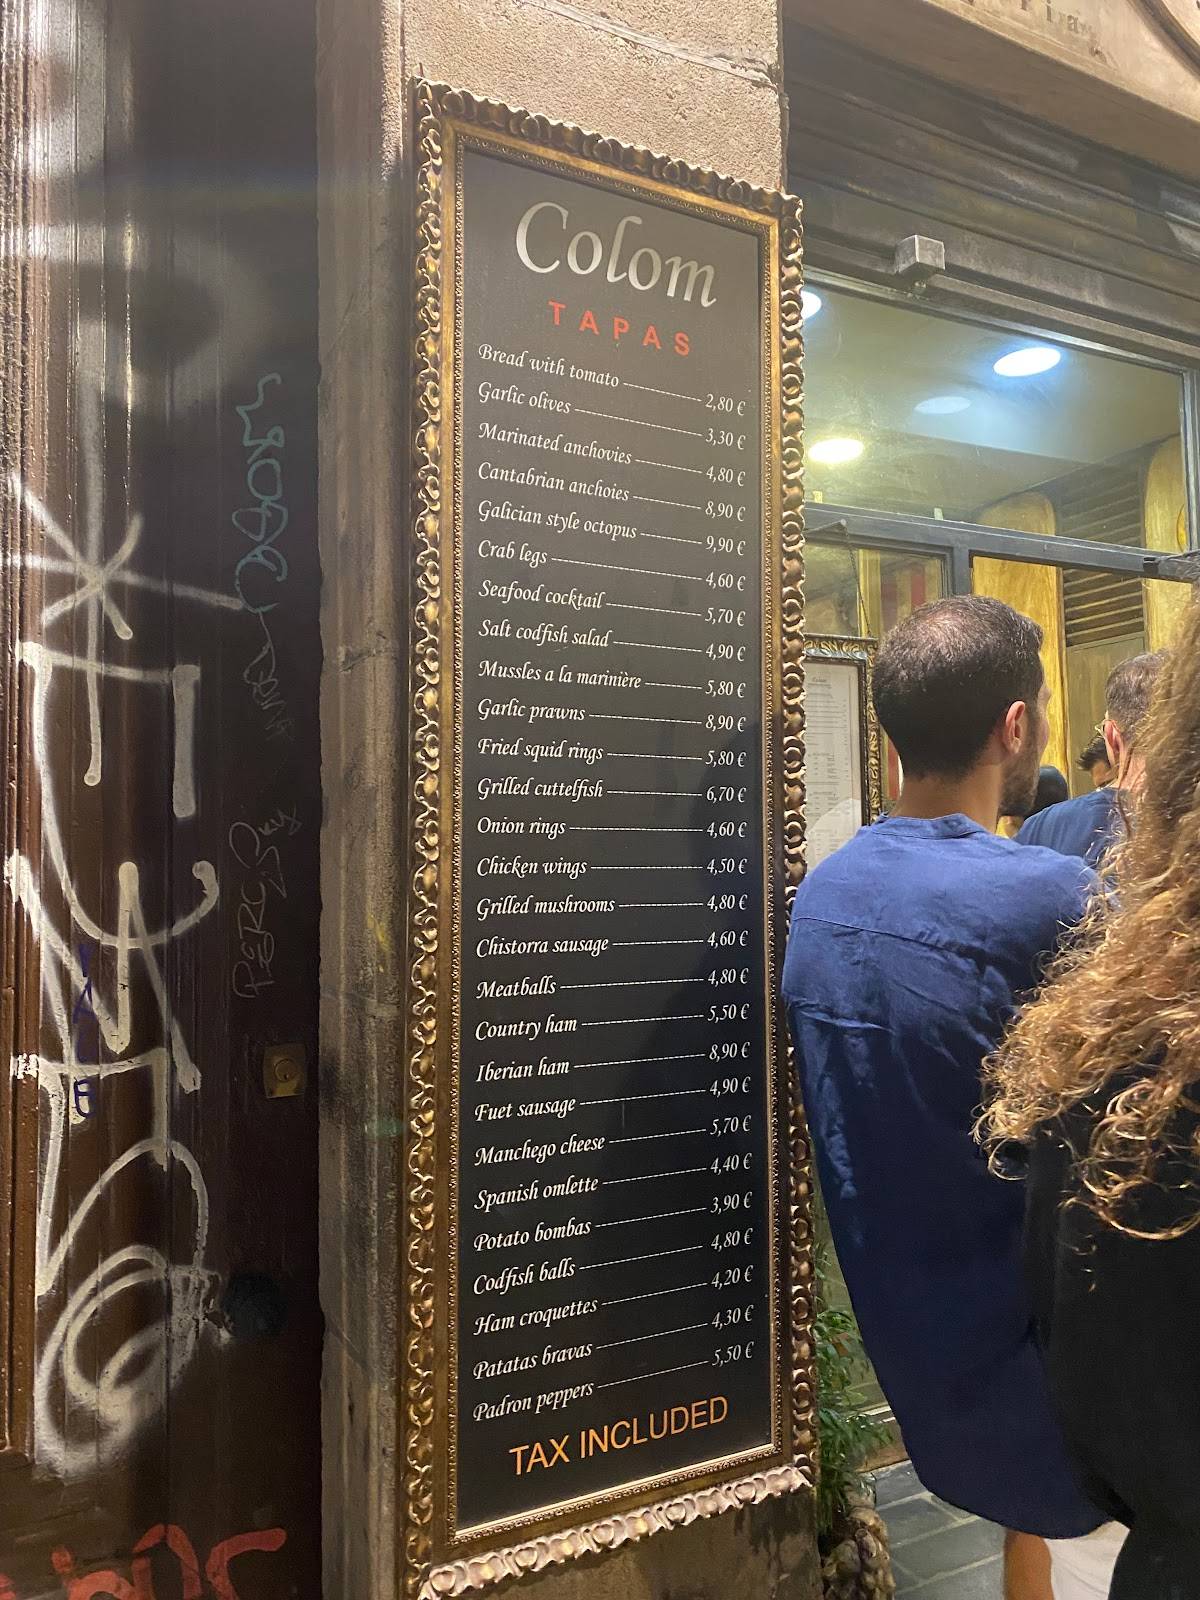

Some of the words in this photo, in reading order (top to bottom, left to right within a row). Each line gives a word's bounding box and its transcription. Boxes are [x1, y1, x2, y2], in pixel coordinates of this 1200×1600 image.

[515, 201, 717, 307] Colom
[547, 299, 690, 357] TAPAS
[479, 344, 528, 367] Bread
[530, 355, 565, 376] with
[570, 365, 619, 387] tomato
[479, 382, 525, 404] Garlic
[529, 392, 571, 413] olives
[479, 423, 561, 452] Marinated
[563, 441, 632, 464] anchovies
[478, 462, 564, 490] Cantabrian
[569, 480, 629, 500] anchoies
[479, 500, 541, 524] Galician
[546, 512, 579, 533] style
[584, 521, 637, 541] octopus
[478, 540, 515, 558] Crab
[520, 543, 547, 568] legs
[478, 580, 544, 604] Seafood
[546, 588, 605, 610] cocktail
[478, 619, 511, 637] Salt
[516, 623, 568, 648] codfish
[572, 628, 612, 647] salad
[478, 660, 542, 681] Mussles
[545, 668, 554, 682] a
[559, 665, 572, 682] la
[577, 670, 641, 688] marinière
[478, 698, 526, 720] Garlic
[528, 706, 585, 723] prawns
[478, 737, 518, 757] Fried
[523, 740, 567, 762] squid
[568, 742, 604, 764] rings
[478, 776, 531, 800] Grilled
[534, 778, 603, 802] cuttelfish
[478, 817, 524, 833] Onion
[529, 817, 566, 840] rings
[477, 856, 538, 878] Chicken
[542, 857, 587, 879] wings
[477, 895, 531, 921] Grilled
[534, 894, 615, 913] mushrooms
[477, 936, 548, 958] Chistorra
[552, 939, 608, 957] sausage
[476, 975, 556, 999] Meatballs
[476, 1021, 541, 1040] Country
[545, 1014, 577, 1033] ham
[476, 1061, 533, 1082] Iberian
[538, 1056, 569, 1075] ham
[475, 1104, 512, 1121] Fuet
[517, 1099, 576, 1118] sausage
[474, 1139, 556, 1166] Manchego
[560, 1134, 605, 1154] cheese
[474, 1180, 538, 1212] Spanish
[543, 1175, 598, 1198] omlette
[474, 1231, 529, 1251] Potato
[535, 1217, 591, 1242] bombas
[474, 1264, 534, 1294] Codfish
[539, 1257, 576, 1281] balls
[473, 1314, 514, 1335] Ham
[520, 1300, 598, 1327] croquettes
[473, 1355, 538, 1379] Patatas
[542, 1344, 592, 1365] bravas
[473, 1394, 531, 1421] Padron
[535, 1383, 594, 1414] peppers
[509, 1435, 570, 1476] TAX
[579, 1395, 728, 1459] INCLUDED
